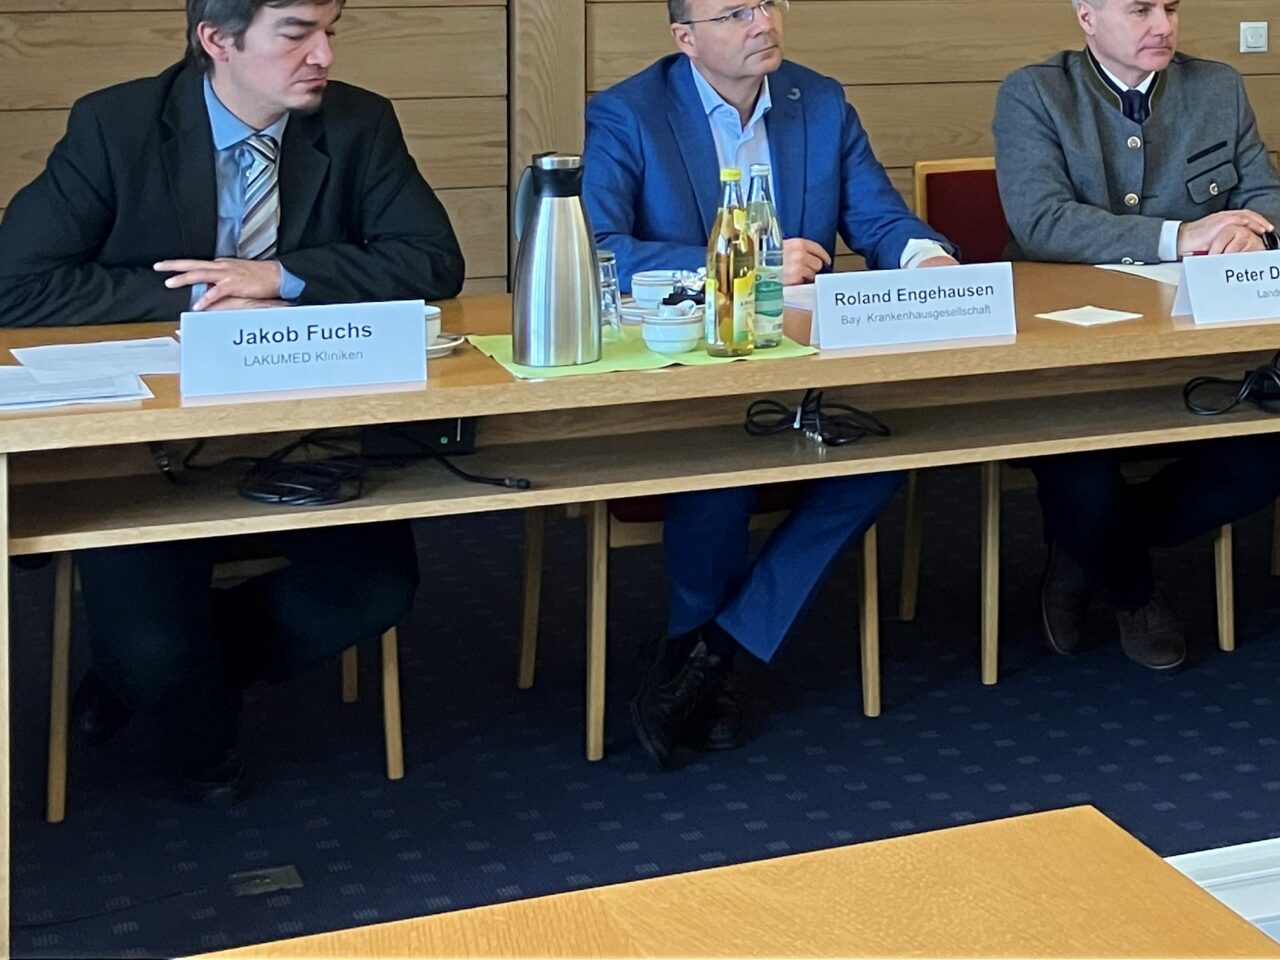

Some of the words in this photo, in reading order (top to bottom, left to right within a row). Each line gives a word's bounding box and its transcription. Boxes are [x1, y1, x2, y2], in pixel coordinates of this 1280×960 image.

[1225, 269, 1265, 284] Peter
[834, 289, 891, 307] Roland
[897, 284, 994, 304] Engehausen
[866, 304, 992, 323] Krankenhausgesellschaft
[232, 326, 299, 347] Jakob
[306, 322, 373, 342] Fuchs
[243, 352, 311, 368] LAKUMED
[315, 349, 364, 363] Kliniken
